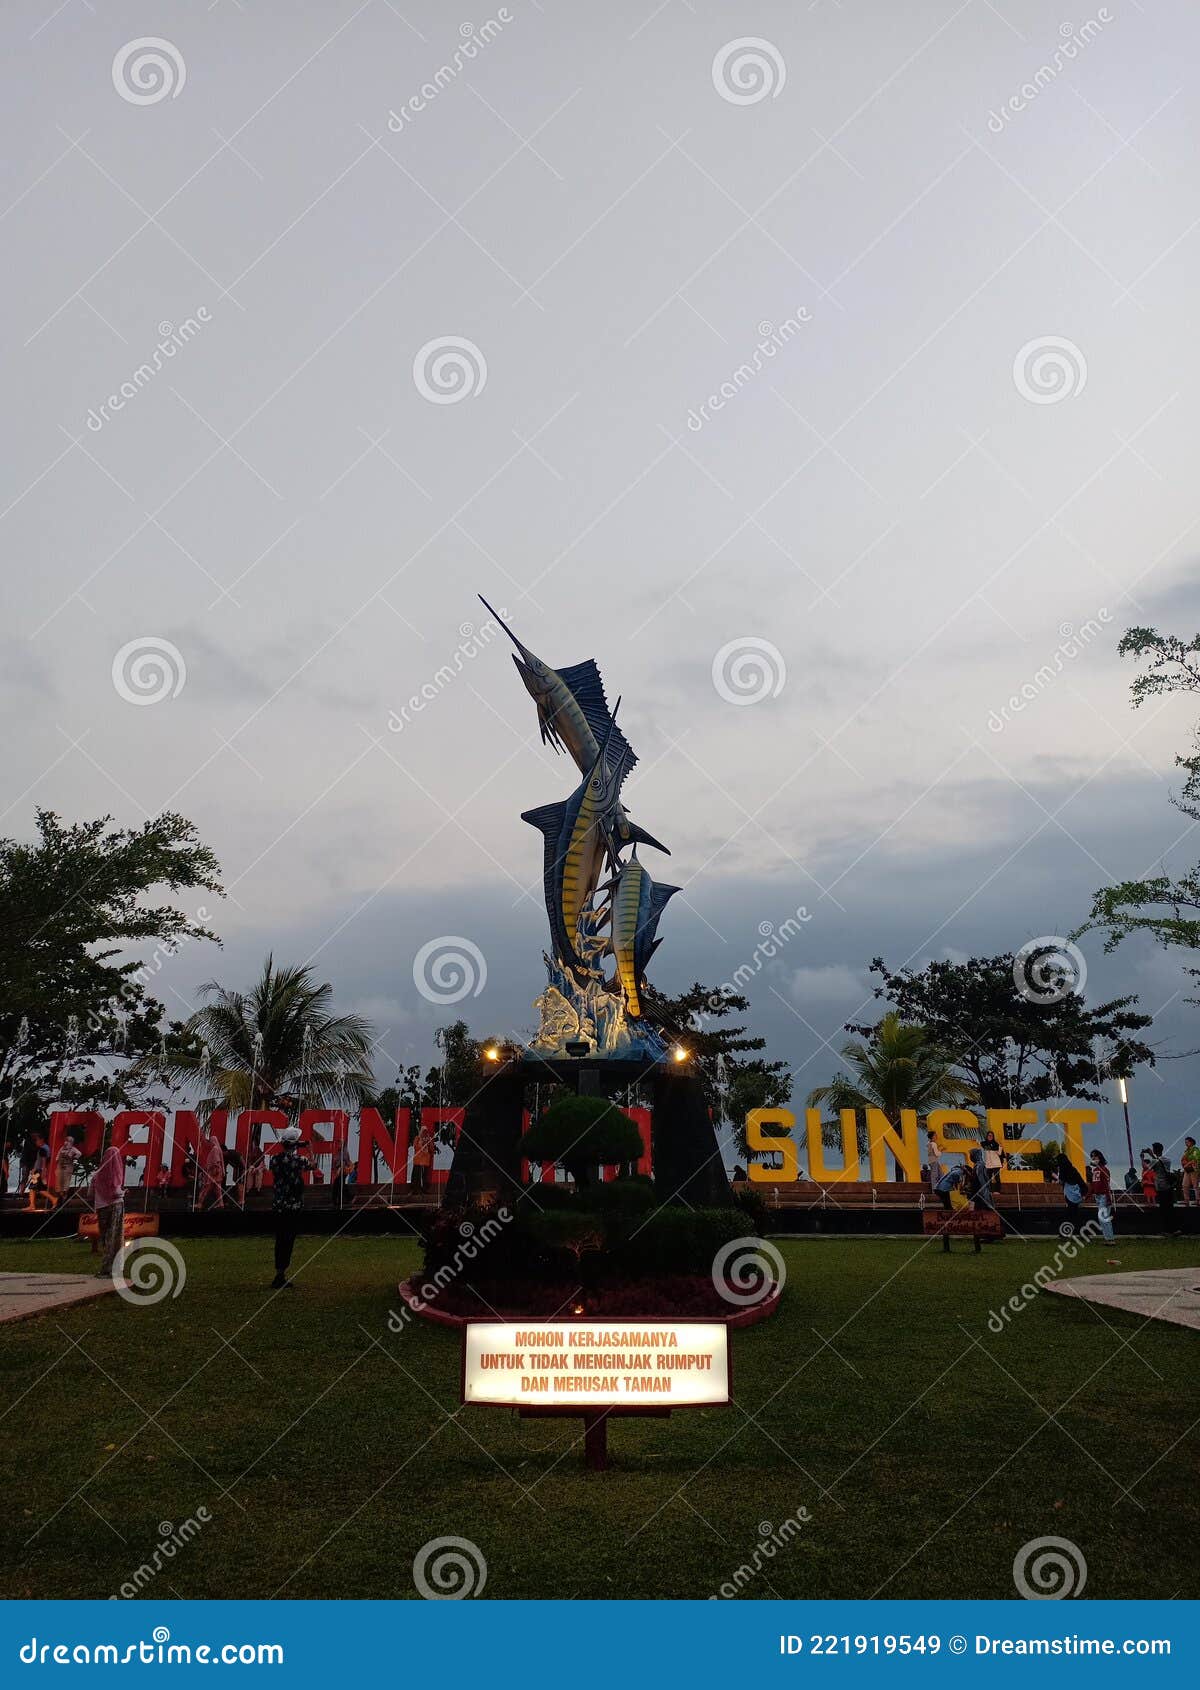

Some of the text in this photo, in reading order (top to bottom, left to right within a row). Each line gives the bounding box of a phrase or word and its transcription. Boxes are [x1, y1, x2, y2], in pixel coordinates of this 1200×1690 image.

[745, 1107, 1098, 1184] SUNSET
[515, 1331, 678, 1347] MOHON KERJASAMANYA
[480, 1354, 712, 1370] UNTUK TIDAK MENGINJAK RUMPUT
[521, 1376, 672, 1392] DAN MERUSAK TAMAN
